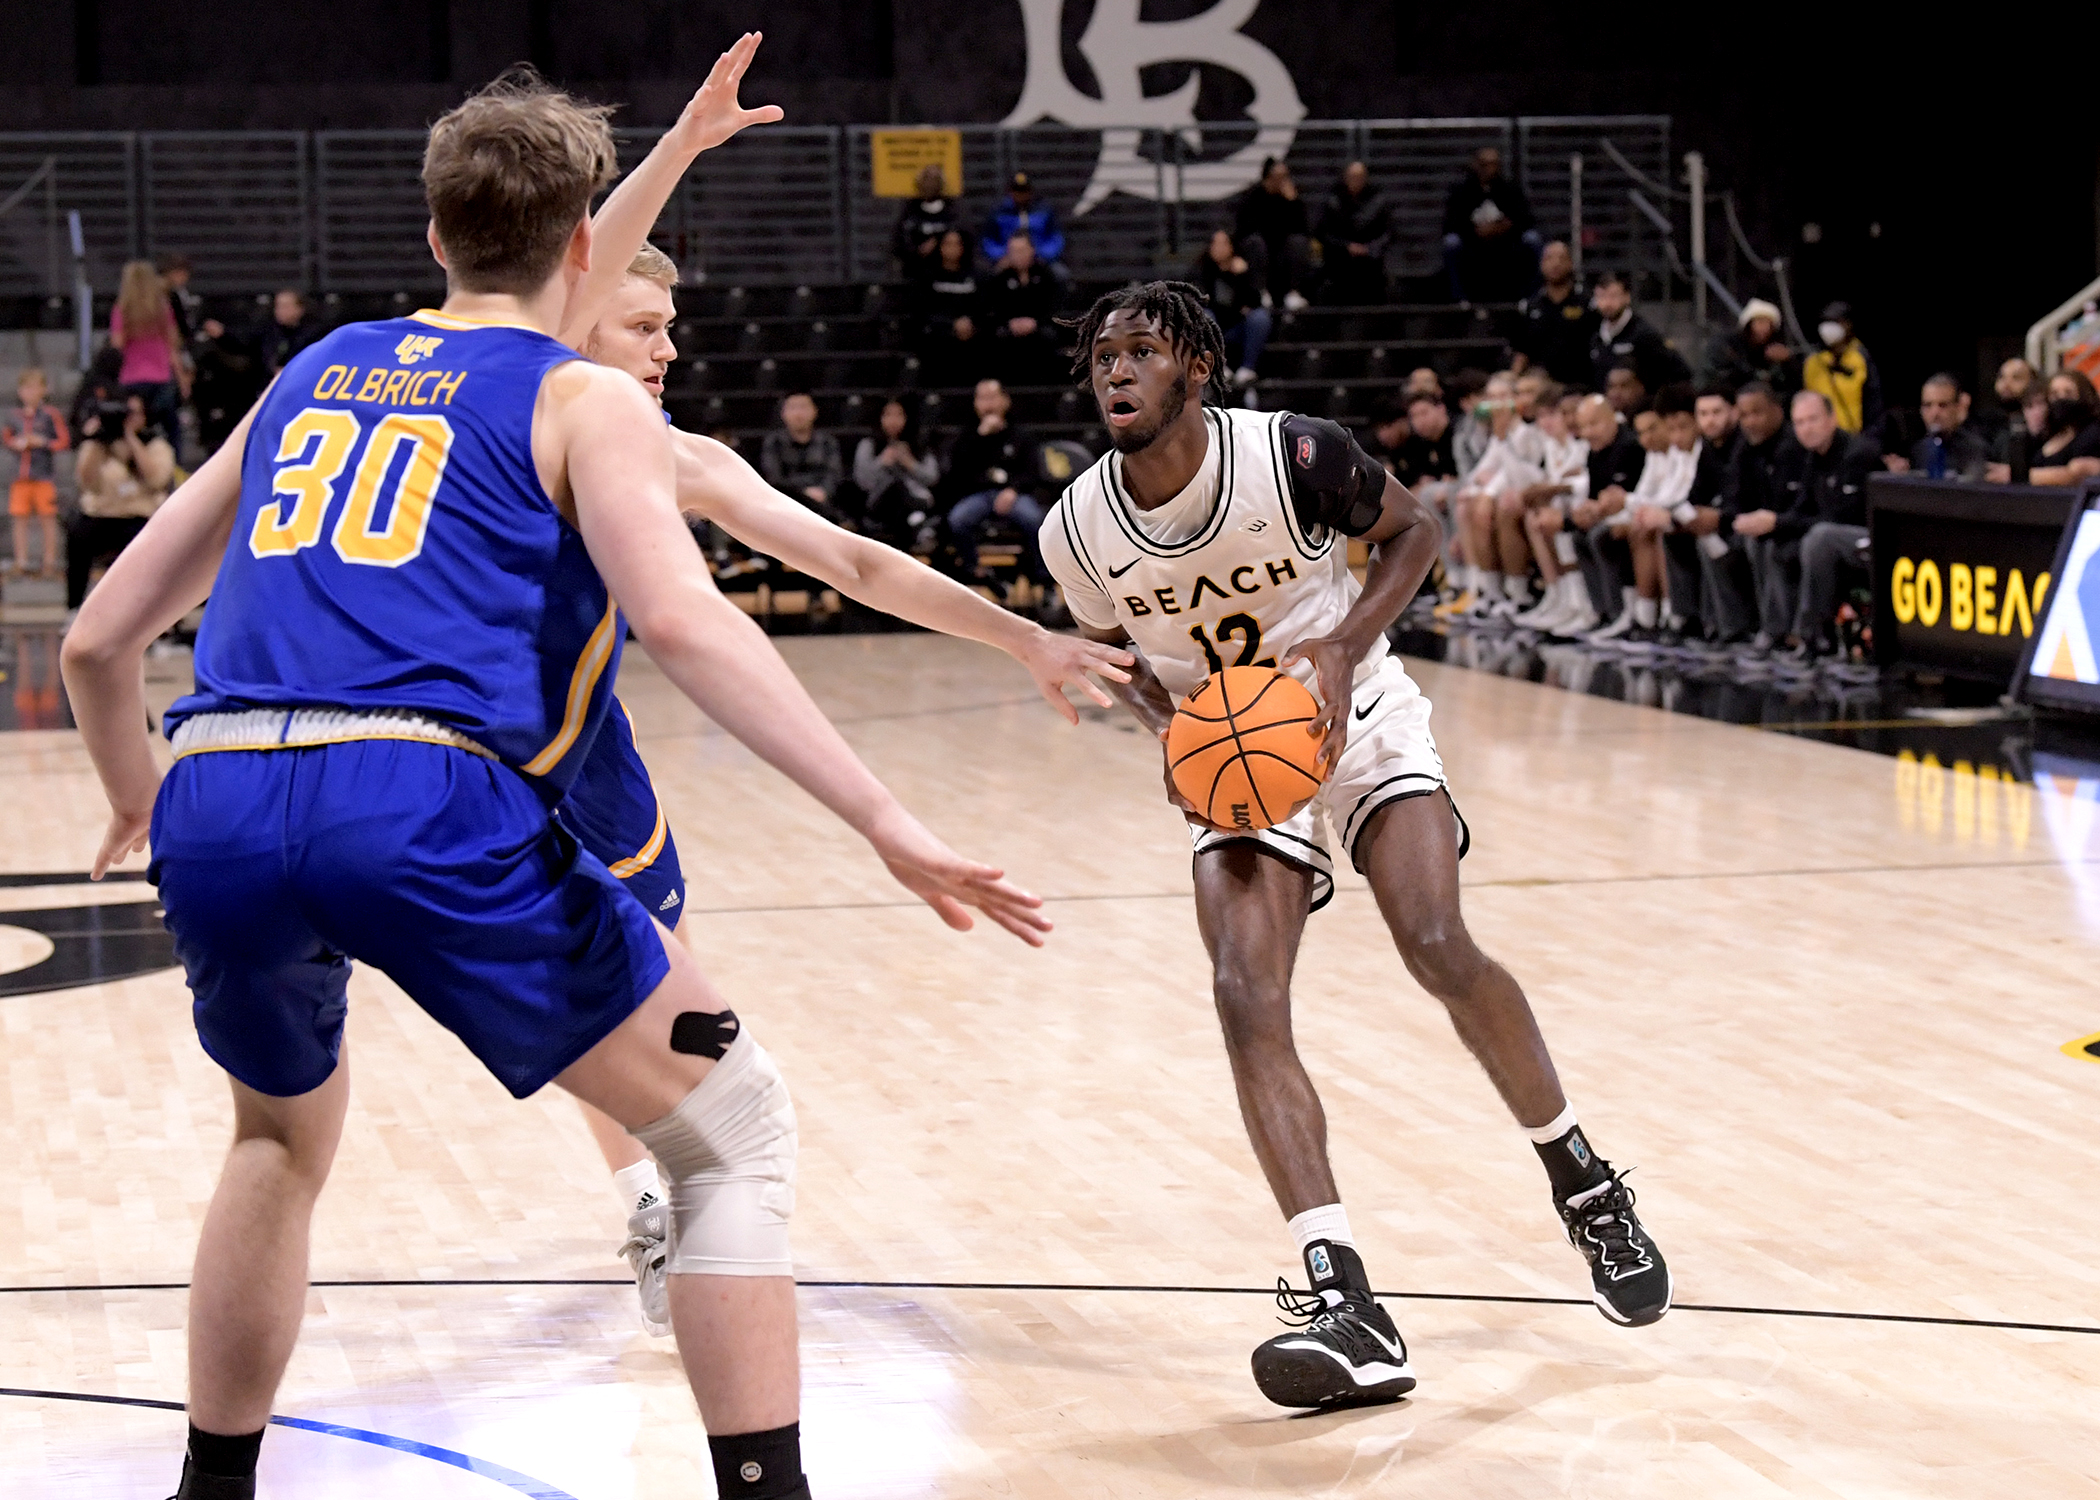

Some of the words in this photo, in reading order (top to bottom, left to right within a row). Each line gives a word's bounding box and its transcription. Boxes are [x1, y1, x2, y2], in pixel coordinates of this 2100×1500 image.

[313, 364, 468, 406] OLBRICH
[249, 407, 455, 569] 30
[1122, 558, 1298, 618] BEACH
[1891, 556, 1943, 628] GO
[1188, 610, 1278, 676] 12
